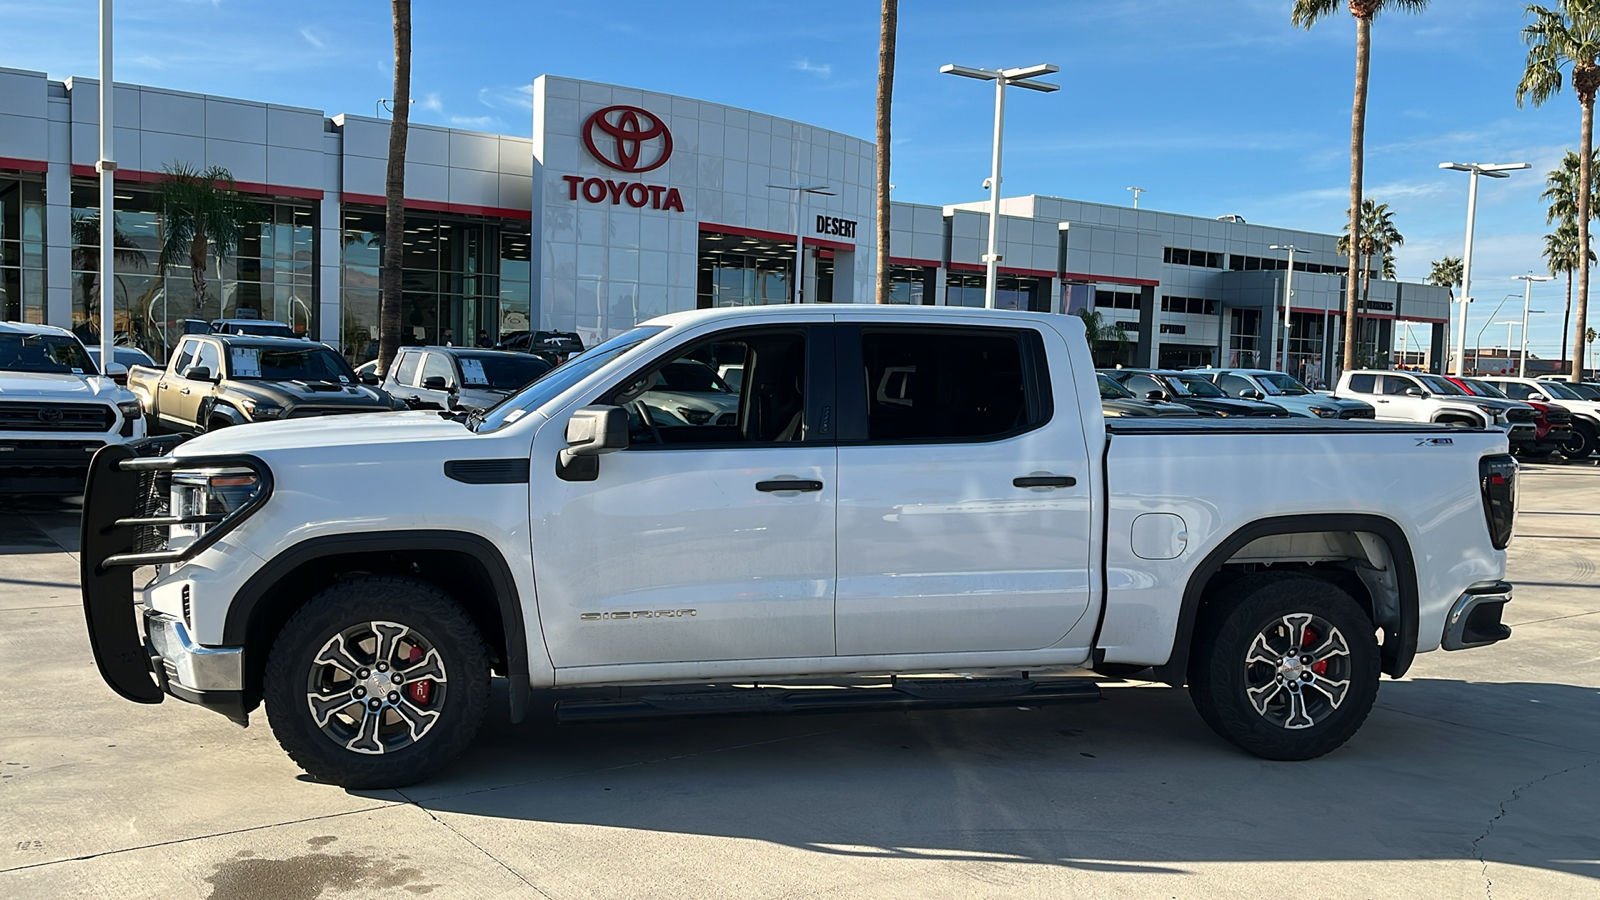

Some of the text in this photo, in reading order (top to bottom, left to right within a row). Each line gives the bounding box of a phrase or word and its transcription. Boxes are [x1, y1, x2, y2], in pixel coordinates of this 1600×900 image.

[562, 175, 685, 213] TOYOTA
[816, 215, 858, 239] DESERT
[580, 608, 697, 621] SIERRA
